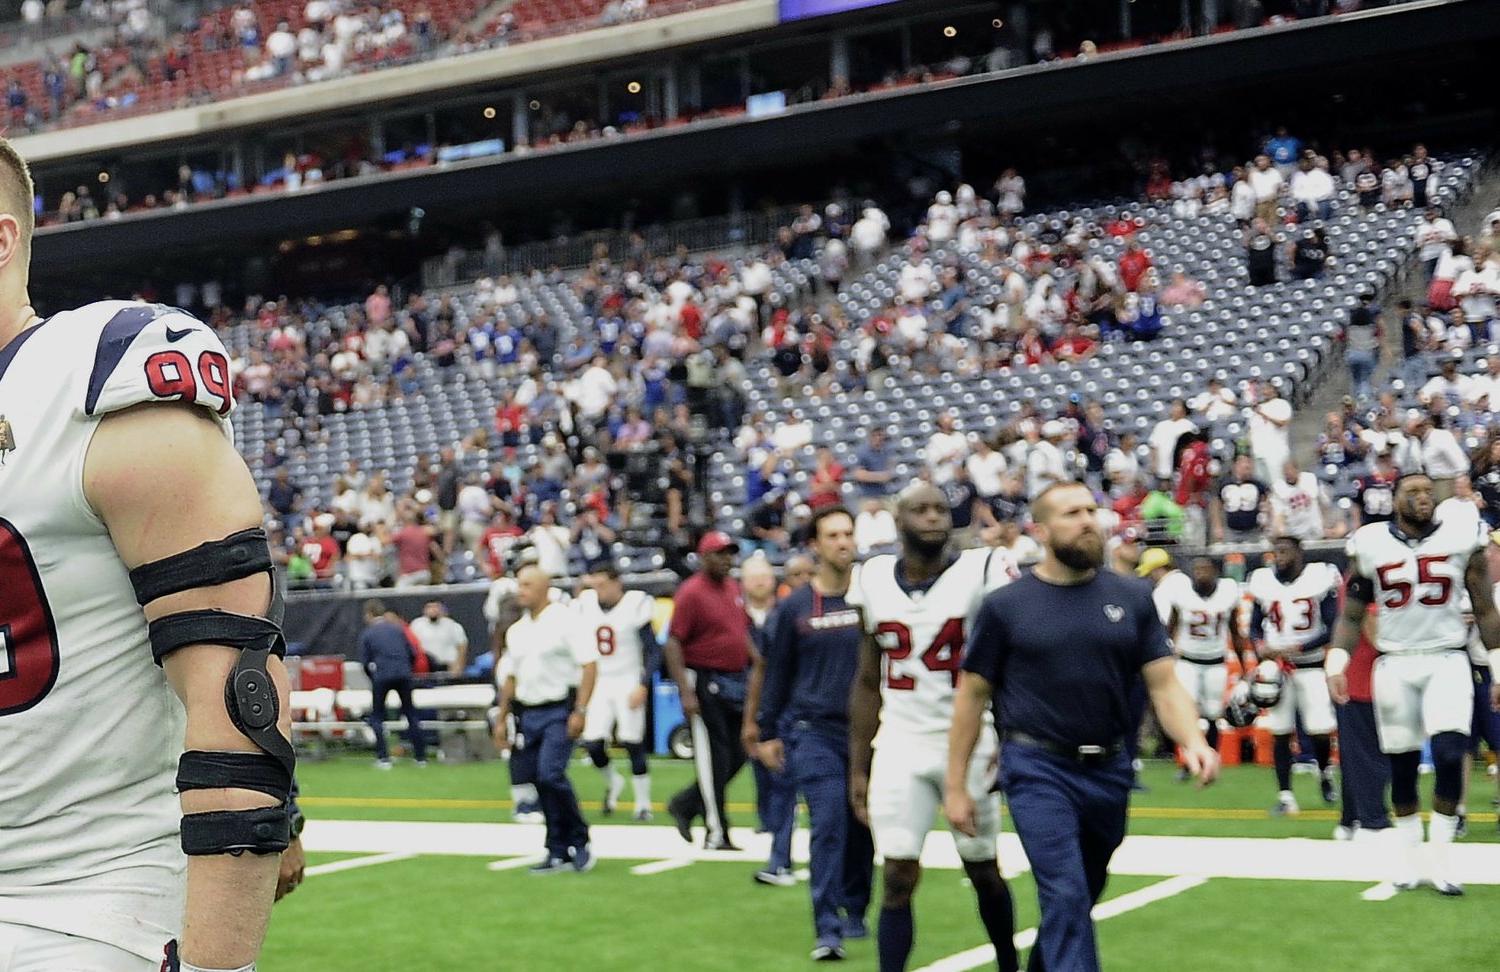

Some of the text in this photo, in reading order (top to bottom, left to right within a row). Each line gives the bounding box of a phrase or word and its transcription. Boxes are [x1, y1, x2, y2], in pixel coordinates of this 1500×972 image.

[144, 350, 231, 414] 99
[1376, 554, 1452, 609] 55
[596, 626, 612, 656] 8
[1268, 597, 1314, 632] 43
[875, 617, 966, 691] 24
